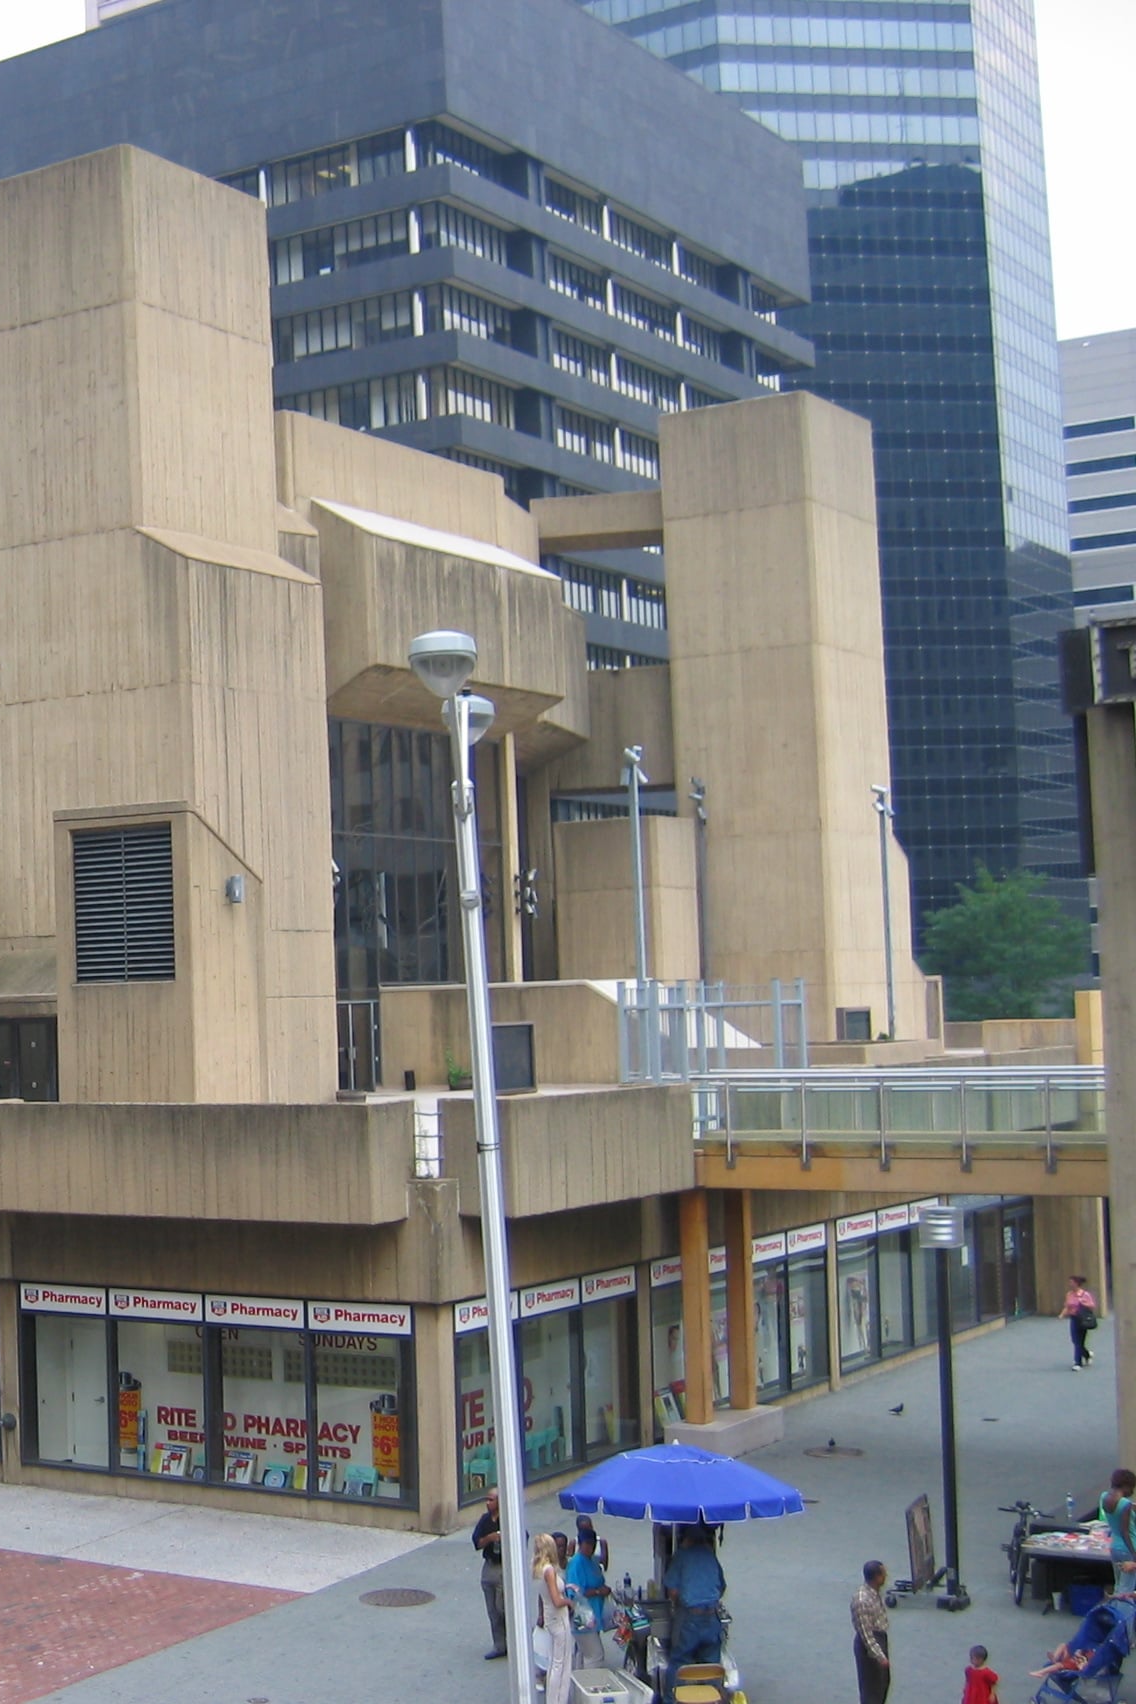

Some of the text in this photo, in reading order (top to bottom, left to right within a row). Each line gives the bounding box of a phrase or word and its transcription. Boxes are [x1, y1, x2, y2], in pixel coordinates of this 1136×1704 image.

[846, 1218, 873, 1232] Pharmacy
[797, 1230, 823, 1243] Pharmacy
[755, 1240, 782, 1254] Pharmacy
[595, 1274, 631, 1290] Pharmacy
[42, 1291, 103, 1308] Pharmacy
[536, 1287, 575, 1304] Pharmacy
[133, 1296, 197, 1314] Pharmacy
[230, 1302, 298, 1321] Pharmacy
[334, 1308, 406, 1327] Pharmacy
[157, 1405, 197, 1428] RITE
[243, 1413, 361, 1445] PHARACY
[224, 1436, 267, 1450] WINE
[283, 1441, 352, 1460] SPRITS
